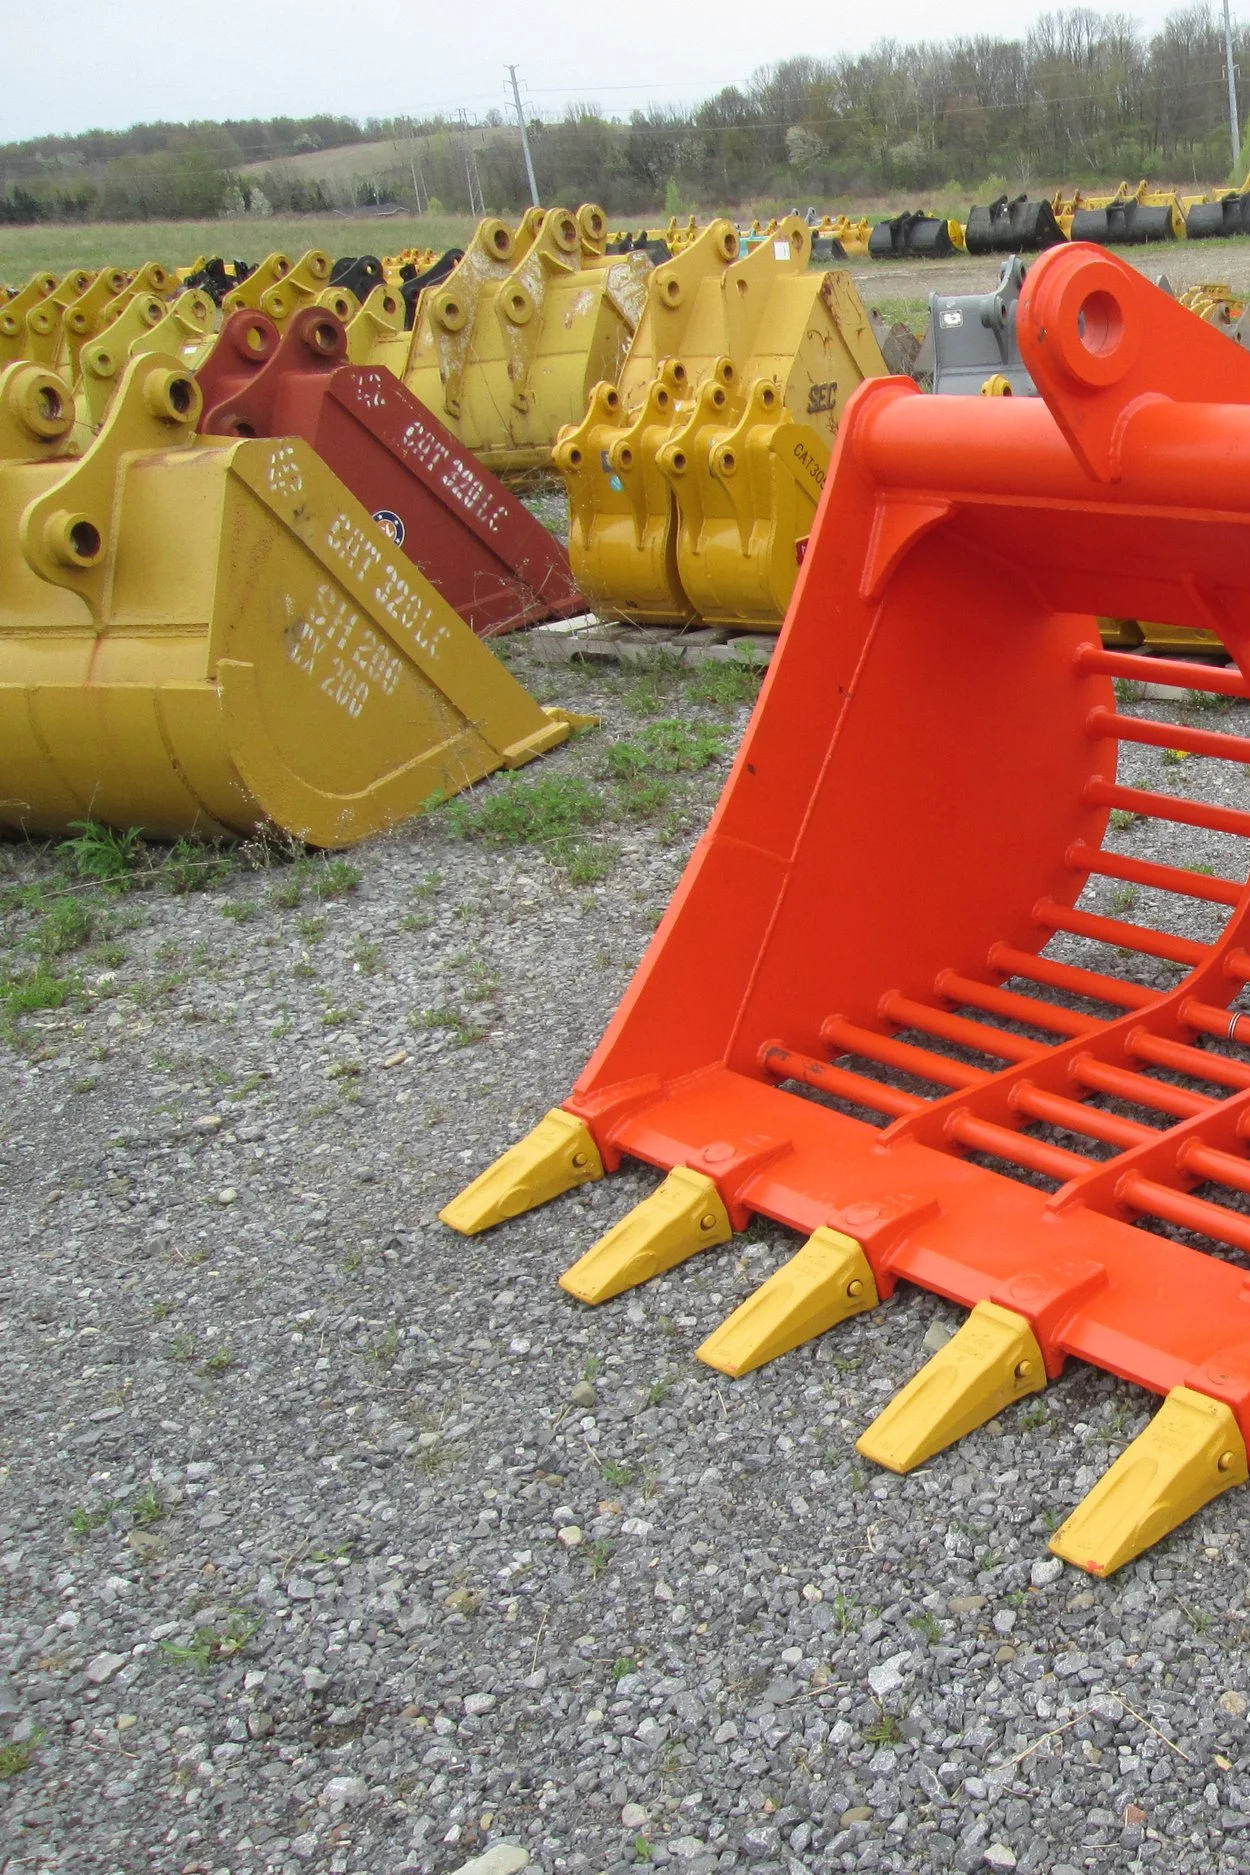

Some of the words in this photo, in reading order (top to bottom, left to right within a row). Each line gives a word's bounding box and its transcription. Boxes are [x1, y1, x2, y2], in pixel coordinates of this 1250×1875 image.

[807, 381, 837, 414] SEC
[403, 421, 449, 472] CAT
[327, 513, 382, 582] CAT
